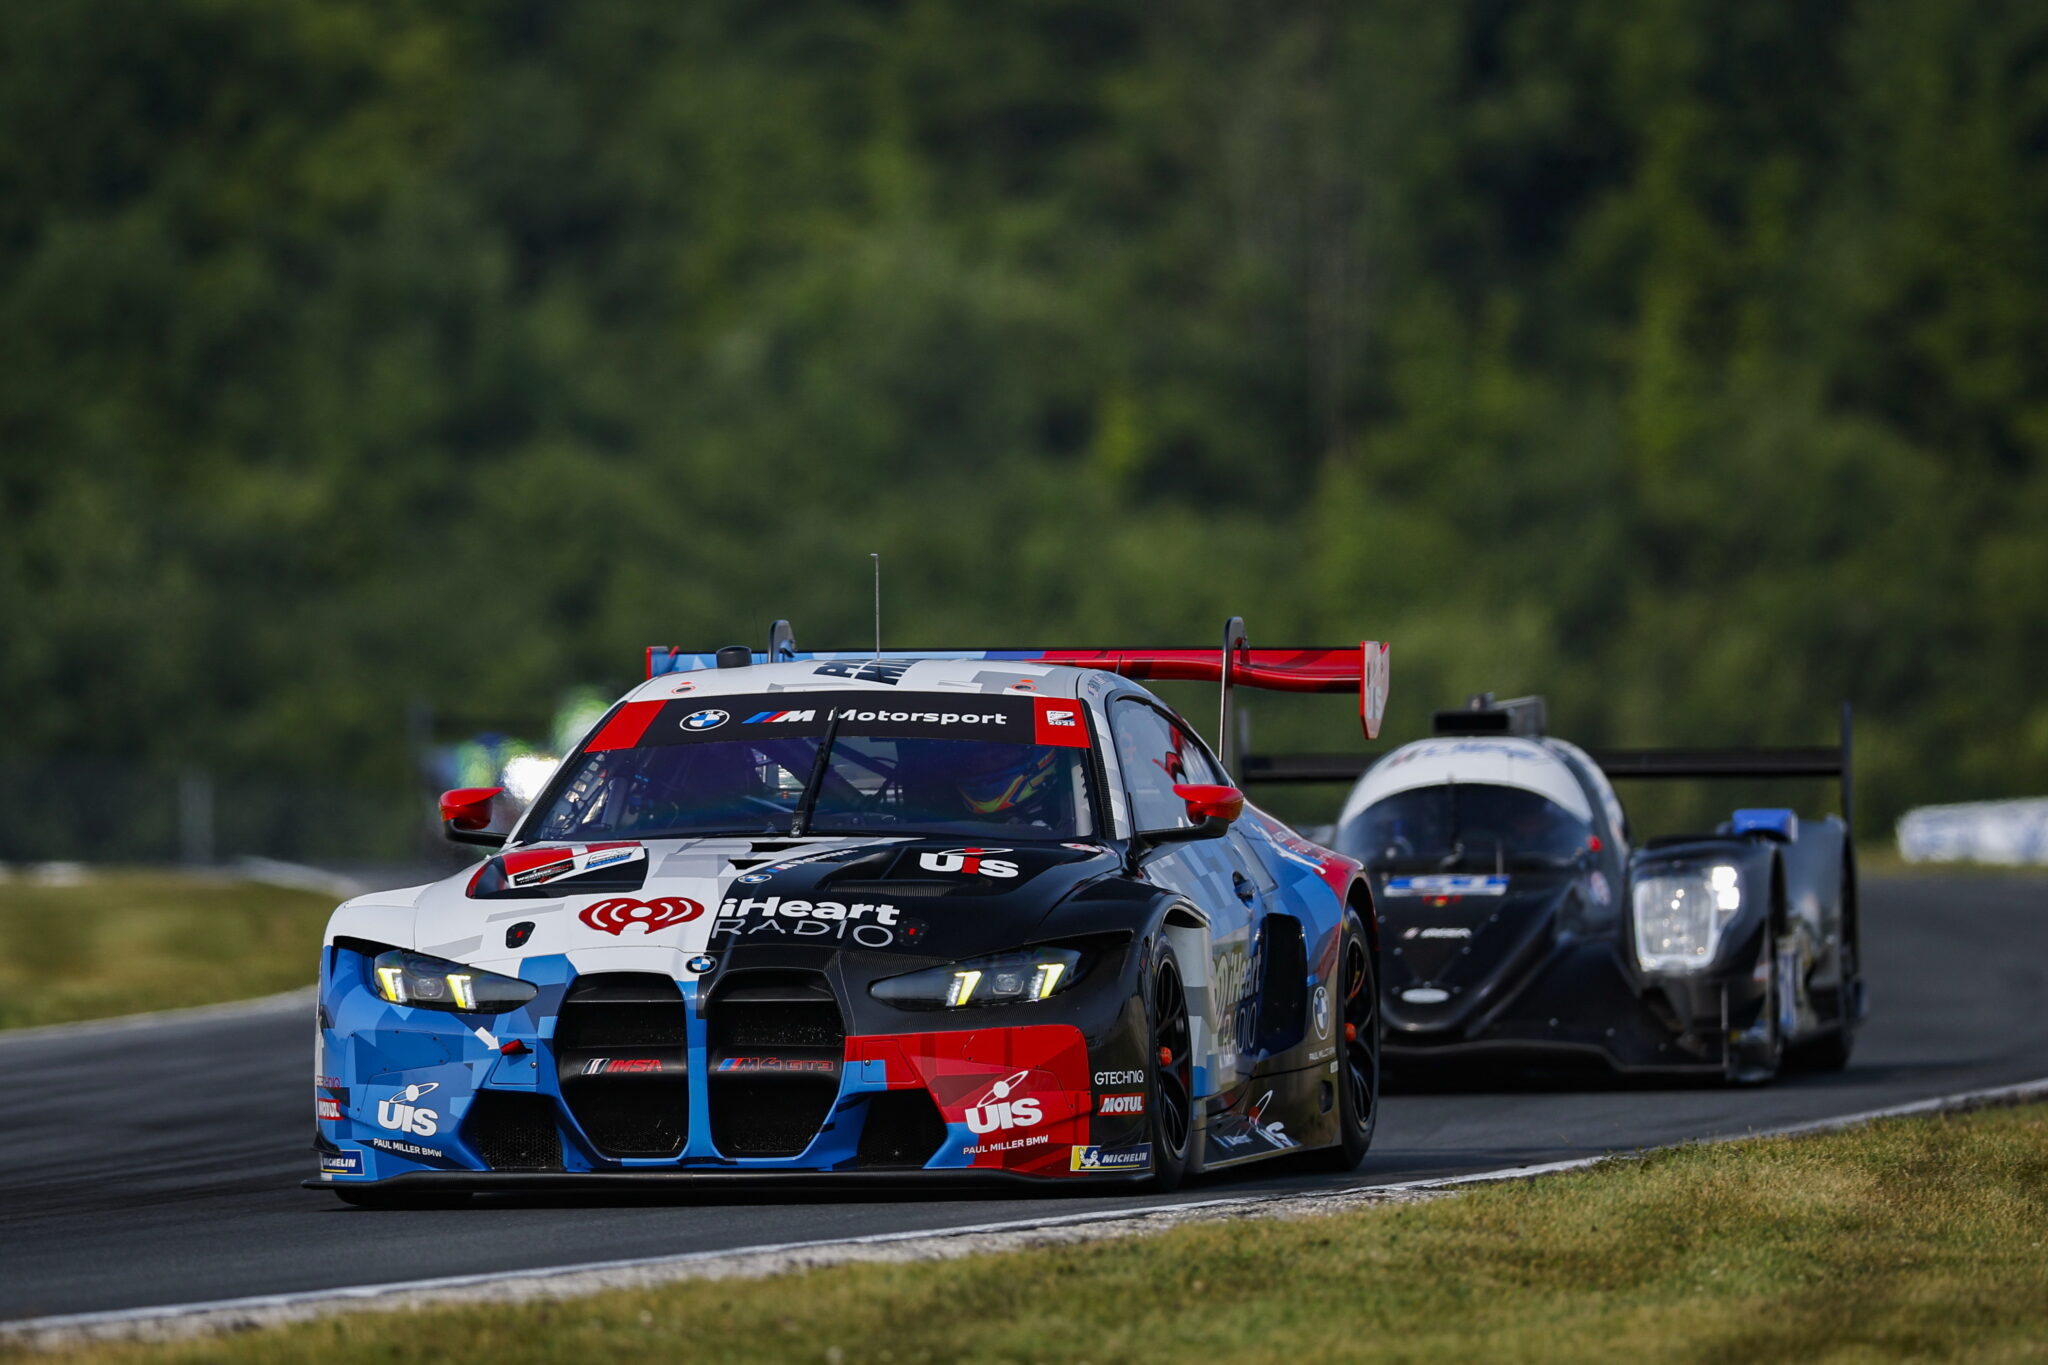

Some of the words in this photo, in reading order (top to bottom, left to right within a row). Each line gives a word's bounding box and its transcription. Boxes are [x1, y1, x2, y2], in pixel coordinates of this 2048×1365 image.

[827, 708, 1008, 725] Motorsport
[718, 896, 900, 926] iHeart
[711, 918, 894, 948] RADIO
[606, 1059, 664, 1072] IMSA
[785, 1059, 834, 1072] GT3
[1094, 1069, 1145, 1086] GTECHNIQ
[319, 1100, 341, 1117] MOTUL
[1100, 1095, 1143, 1113] MOTUL
[377, 1099, 439, 1137] UIS
[965, 1098, 1043, 1134] UIS
[373, 1138, 393, 1149] PAUL
[392, 1141, 421, 1154] MILLER
[421, 1147, 443, 1158] BMW
[962, 1145, 988, 1155] PAUL
[989, 1139, 1025, 1152] MILLER
[1025, 1134, 1049, 1147] BMW
[1101, 1151, 1148, 1164] MICHELIN
